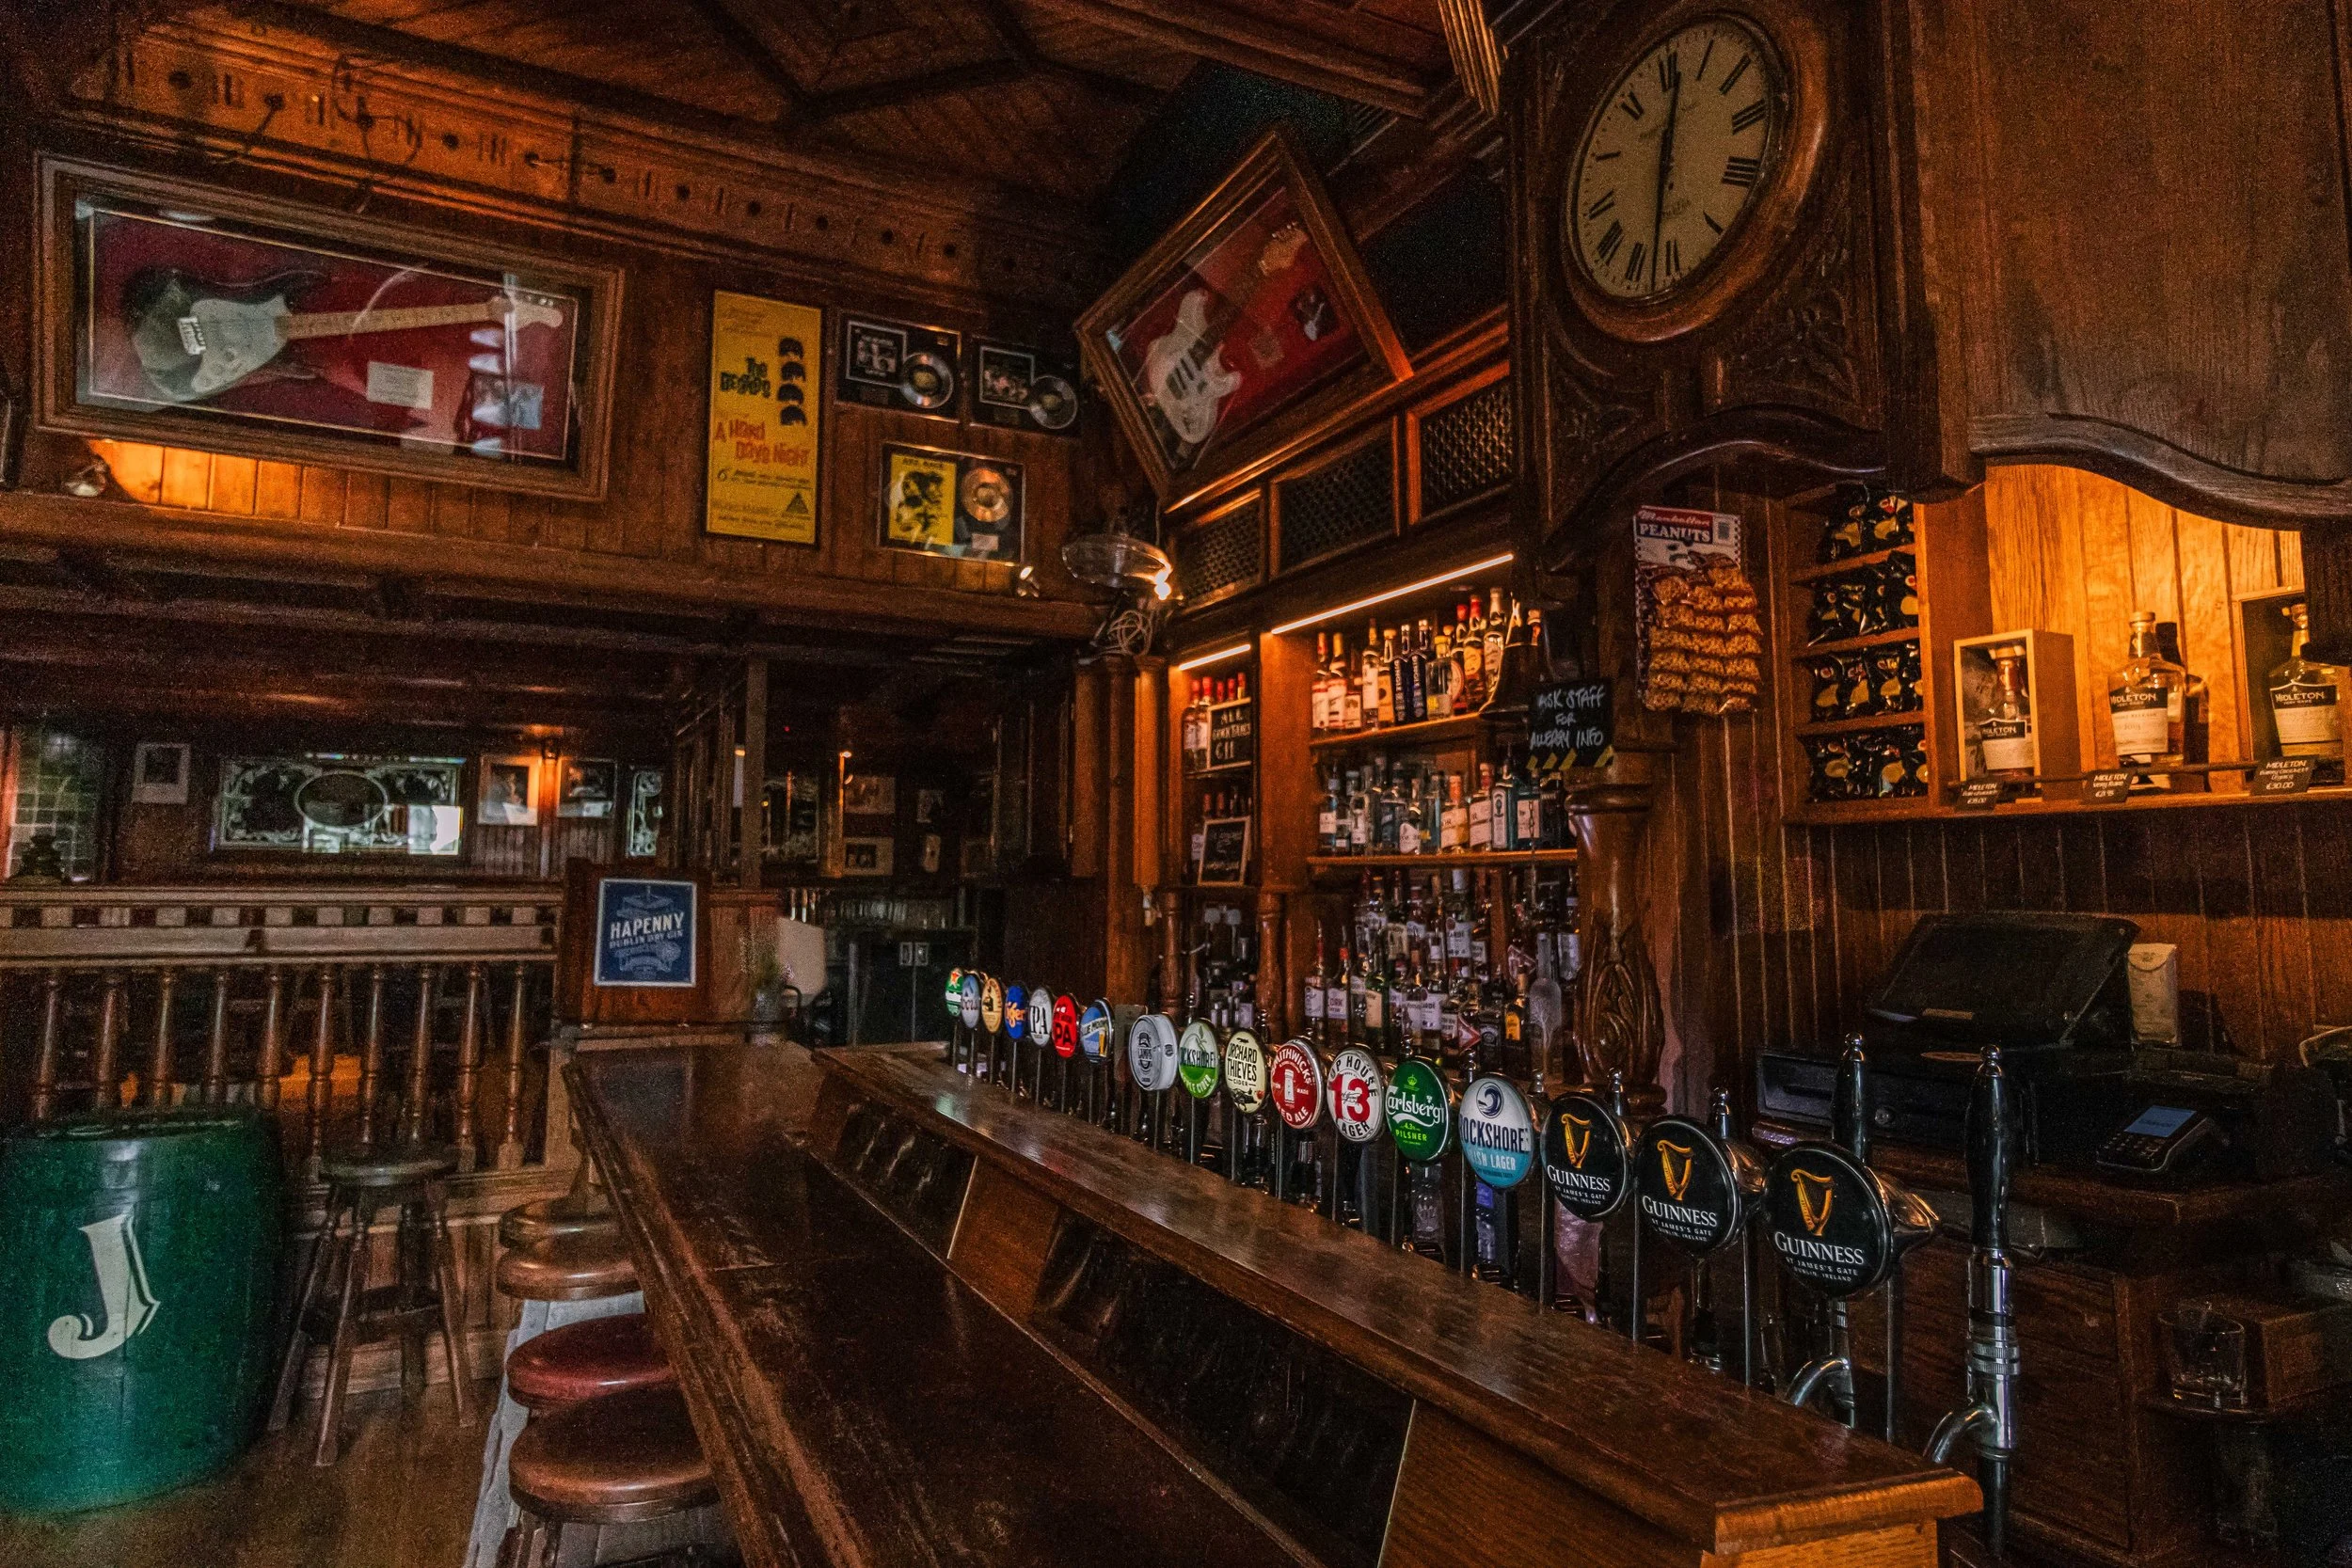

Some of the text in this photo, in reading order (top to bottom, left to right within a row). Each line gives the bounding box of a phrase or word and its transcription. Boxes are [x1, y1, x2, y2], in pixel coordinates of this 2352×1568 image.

[1639, 523, 1710, 543] PEANUTS
[1537, 685, 1605, 709] ASK STAFF
[2274, 691, 2326, 703] MIDLETON
[1555, 712, 1577, 726] FOR
[1577, 726, 1604, 749] INFO
[610, 911, 685, 940] HAPENNY
[1227, 1058, 1258, 1083] THIEVES
[1345, 1055, 1378, 1098] HOUSE
[1328, 1072, 1371, 1123] 13
[1385, 1085, 1441, 1125] Carlsberg
[1293, 1105, 1310, 1123] ALE
[1395, 1129, 1428, 1142] PILSNER
[1490, 1154, 1517, 1171] LAGER
[1547, 1164, 1612, 1193] GUINNESS
[1590, 1192, 1607, 1201] GATE
[1641, 1194, 1719, 1228] GUINNESS
[1661, 1221, 1692, 1234] JAMES'S
[1693, 1227, 1712, 1237] GATE
[1773, 1230, 1866, 1266] GUINNESS
[1797, 1259, 1834, 1274] JAMES'S
[1836, 1266, 1860, 1277] GATE
[48, 1210, 161, 1360] J
